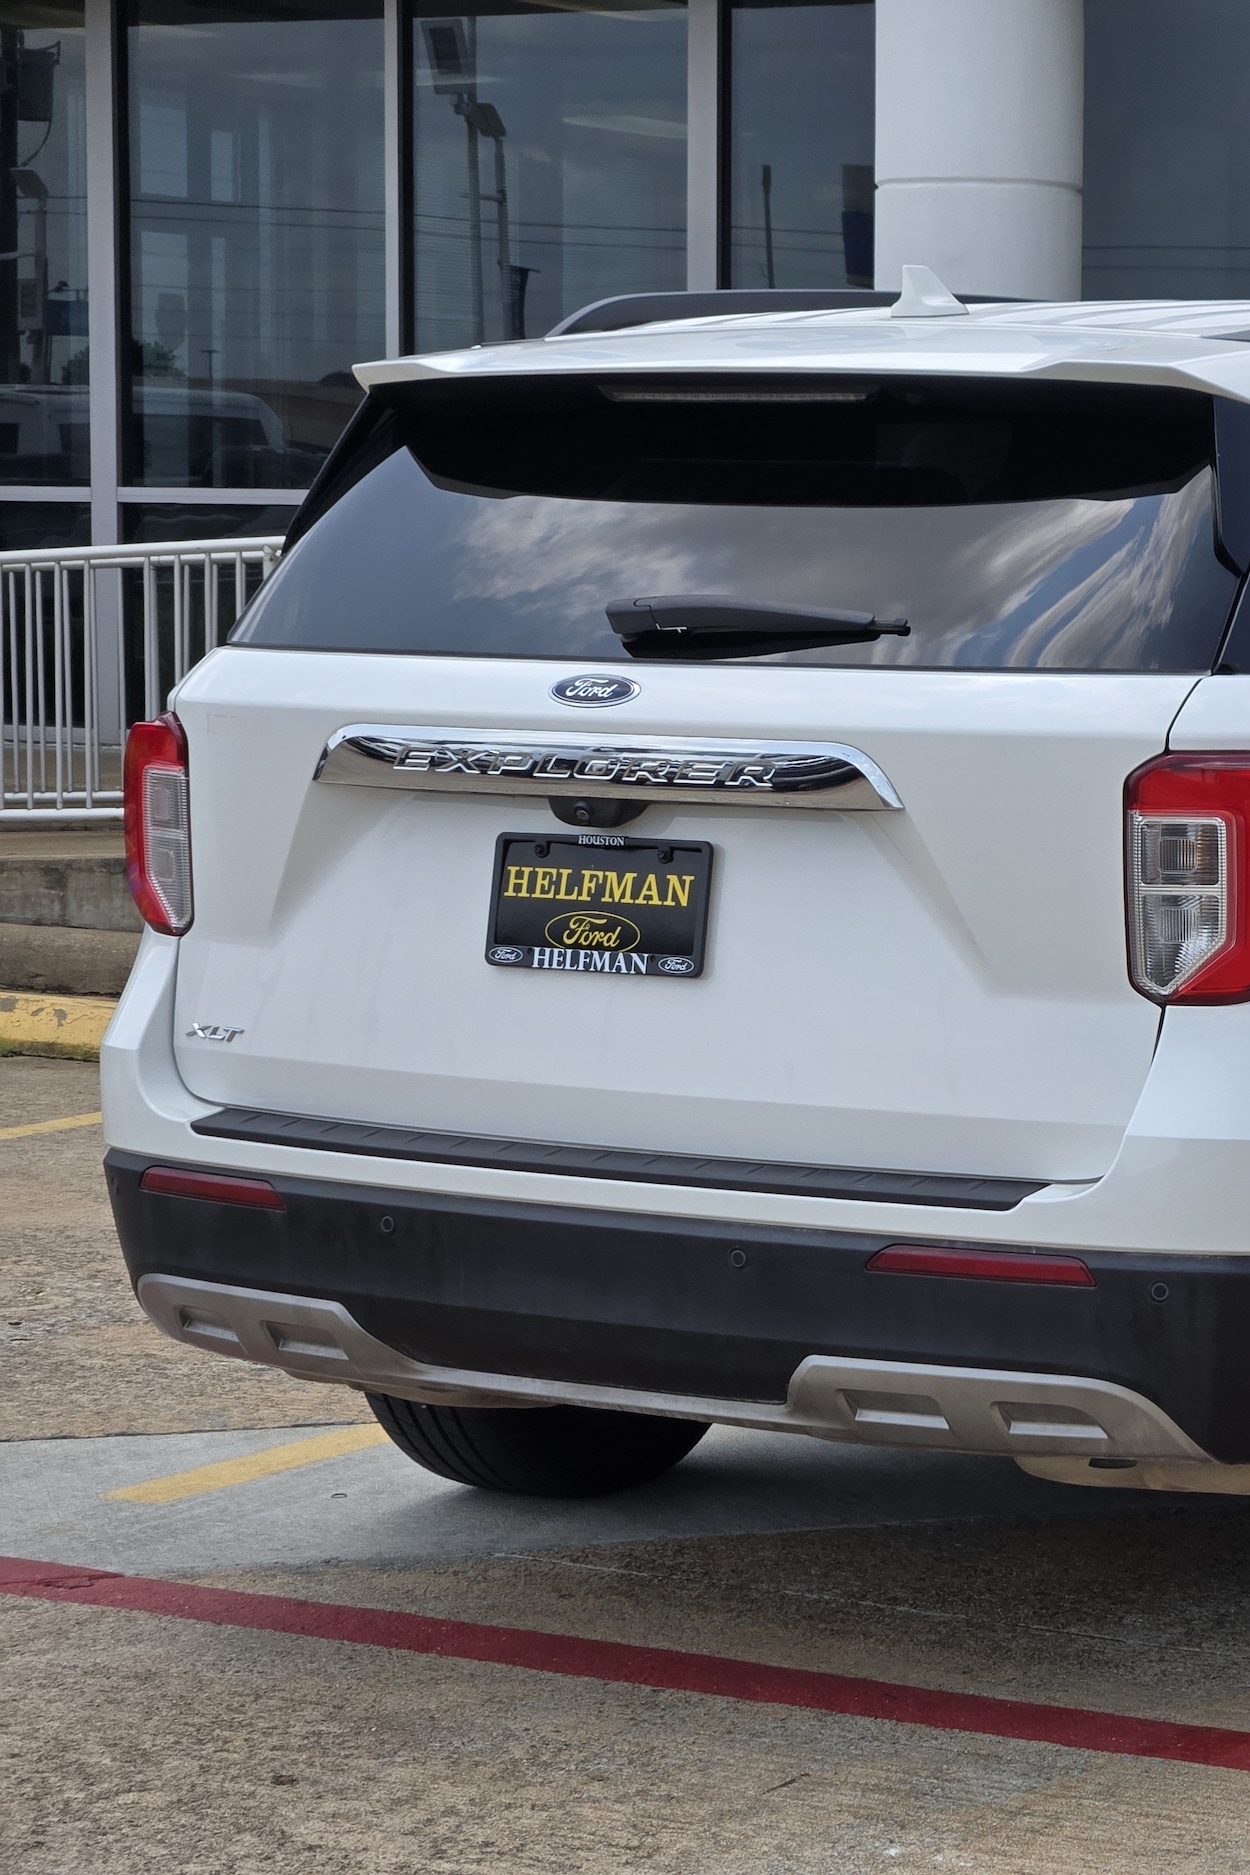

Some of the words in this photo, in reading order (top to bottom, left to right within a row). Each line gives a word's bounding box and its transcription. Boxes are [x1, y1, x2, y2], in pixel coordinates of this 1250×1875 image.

[565, 678, 618, 698] Ford
[393, 746, 778, 788] EXPLORER
[578, 835, 625, 846] HOUSTON
[503, 866, 695, 907] HELFMAN
[562, 915, 622, 948] Ford
[494, 949, 517, 961] Ford
[531, 947, 649, 975] HELFMAN
[664, 958, 688, 971] Ford
[185, 1022, 245, 1042] XLT
